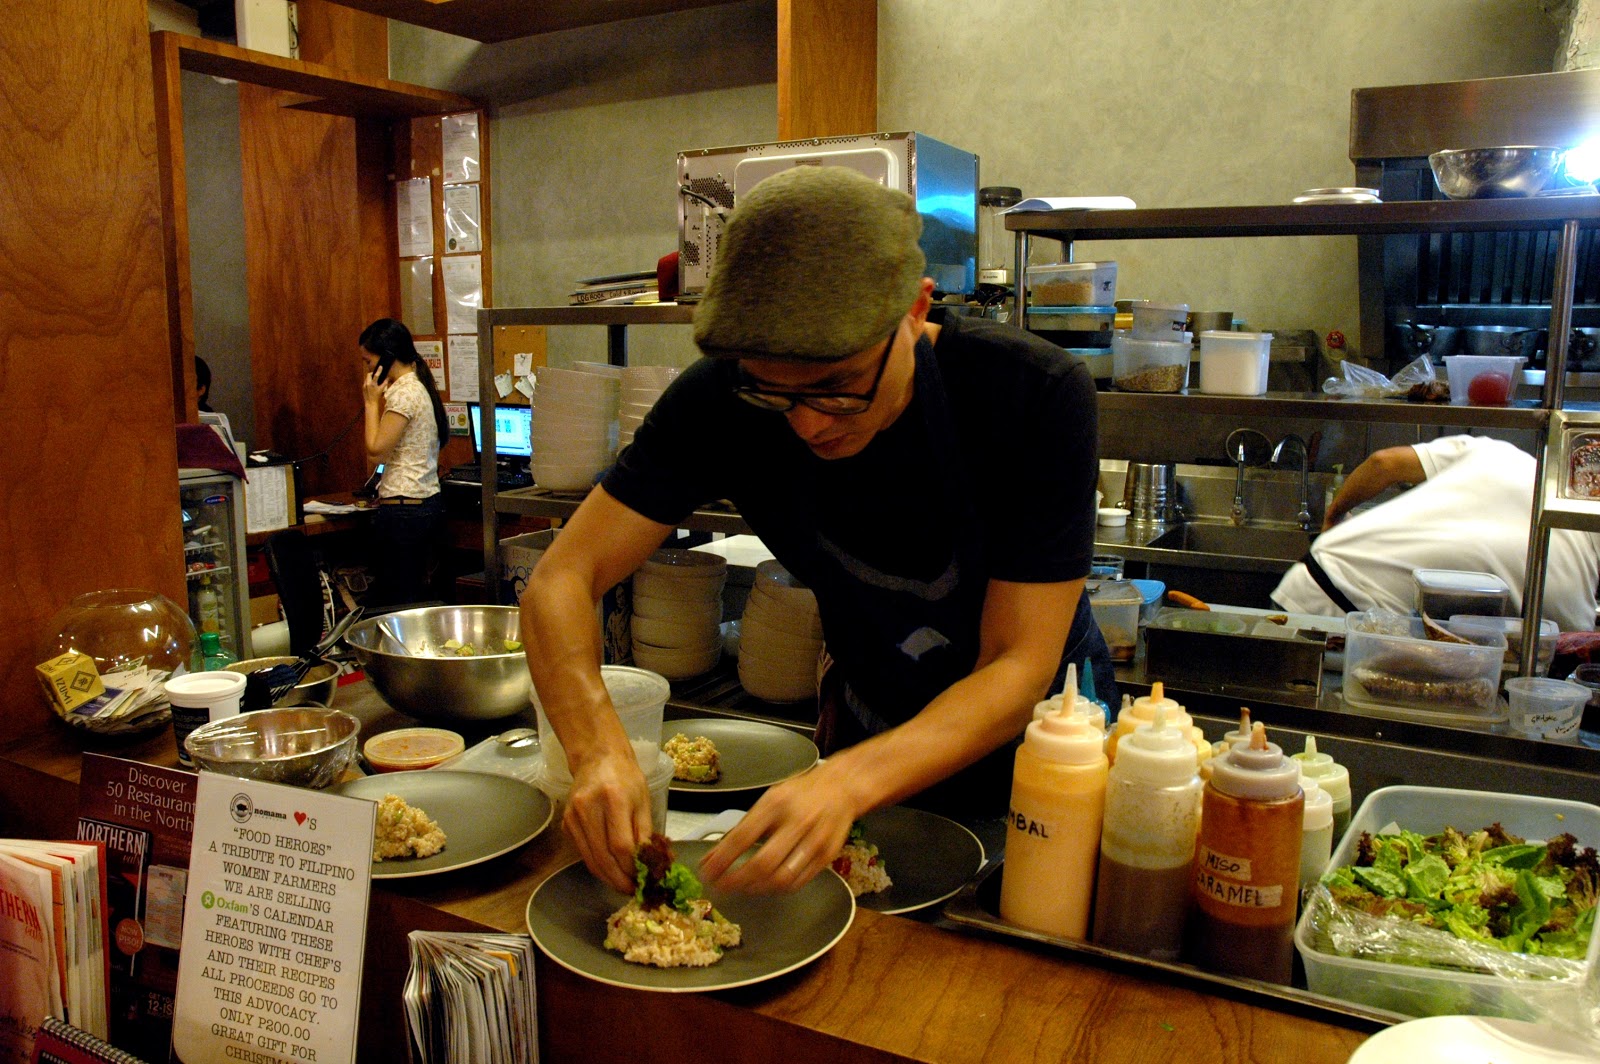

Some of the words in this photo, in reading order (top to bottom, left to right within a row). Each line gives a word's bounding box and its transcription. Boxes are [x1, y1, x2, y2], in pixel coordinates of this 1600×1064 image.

[55, 677, 73, 705] IZUMI
[106, 781, 124, 798] 50
[128, 767, 188, 794] Discover
[113, 800, 126, 817] in
[130, 804, 152, 823] the
[155, 809, 194, 833] North
[254, 808, 287, 820] nomama
[76, 820, 144, 856] NORTHERN
[208, 841, 218, 853] A
[222, 842, 275, 865] TRIBUTE
[279, 854, 295, 869] TO
[299, 858, 355, 881] FILIPINO
[1205, 851, 1240, 873] MISO
[222, 861, 270, 882] WOMEN
[274, 872, 336, 896] FARMERS
[1198, 872, 1264, 906] ARAMEL
[224, 879, 243, 894] WE
[247, 885, 273, 901] ARE
[277, 891, 331, 914] SELLING
[216, 914, 286, 941] FEATURING
[290, 931, 333, 952] THESE
[264, 907, 334, 934] CALENDAR
[205, 929, 254, 951] HEROES
[258, 942, 291, 961] WITH
[207, 949, 234, 966] AND
[238, 955, 277, 976] THEIR
[281, 966, 335, 990] RECIPES
[201, 966, 226, 982] ALL
[229, 972, 295, 999] PROCEEDS
[299, 989, 316, 1005] GO
[321, 995, 338, 1010] TO
[213, 986, 242, 1005] THIS
[245, 996, 320, 1025] ADVOCACY.
[220, 1007, 254, 1026] ONLY
[258, 1017, 310, 1041] P200.00
[211, 1023, 254, 1045] GREAT
[257, 1036, 287, 1053] GIFT
[290, 1044, 317, 1062] FOR
[225, 1045, 297, 1064] CHRISTM
